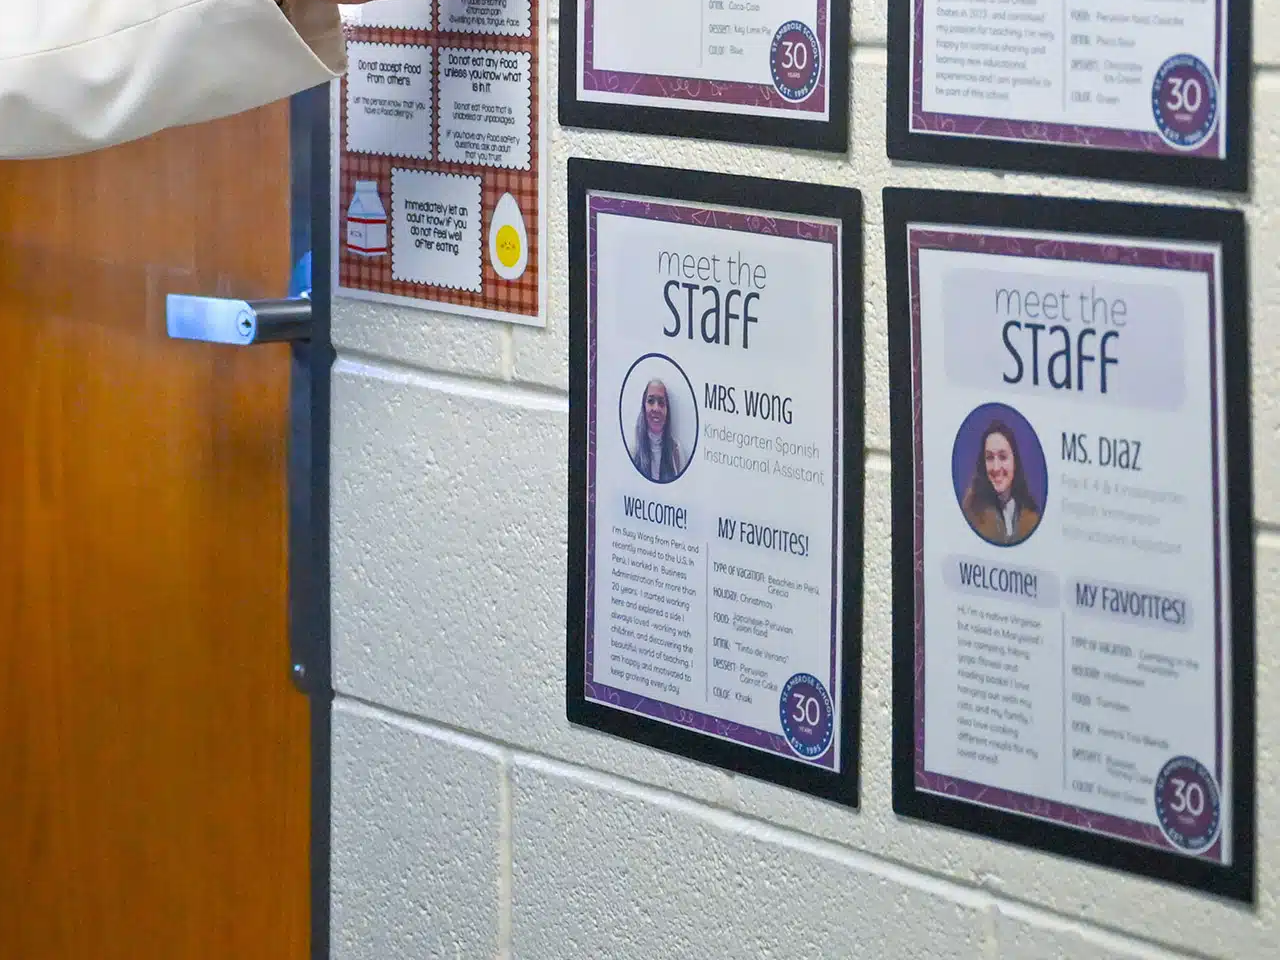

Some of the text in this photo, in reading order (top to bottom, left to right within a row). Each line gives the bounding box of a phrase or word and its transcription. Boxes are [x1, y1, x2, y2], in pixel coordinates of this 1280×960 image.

[368, 62, 378, 70] not
[404, 63, 421, 74] food
[781, 41, 807, 70] 30
[367, 73, 385, 83] from
[1167, 77, 1202, 112] 30
[405, 199, 468, 216] Immediately let an
[427, 215, 445, 226] know
[446, 217, 452, 226] if
[454, 220, 467, 230] you
[411, 225, 462, 241] do not feel well
[415, 239, 434, 249] after
[658, 248, 766, 289] meet the
[996, 286, 1128, 327] meet the
[704, 382, 739, 415] MRS.
[704, 423, 819, 459] Kindergarten Spanish
[1062, 432, 1092, 464] MS.
[703, 446, 824, 486] Instructional Assistant
[665, 583, 681, 592] more
[740, 593, 772, 609] Christmas
[792, 693, 819, 726] 30
[1171, 778, 1204, 817] 30
